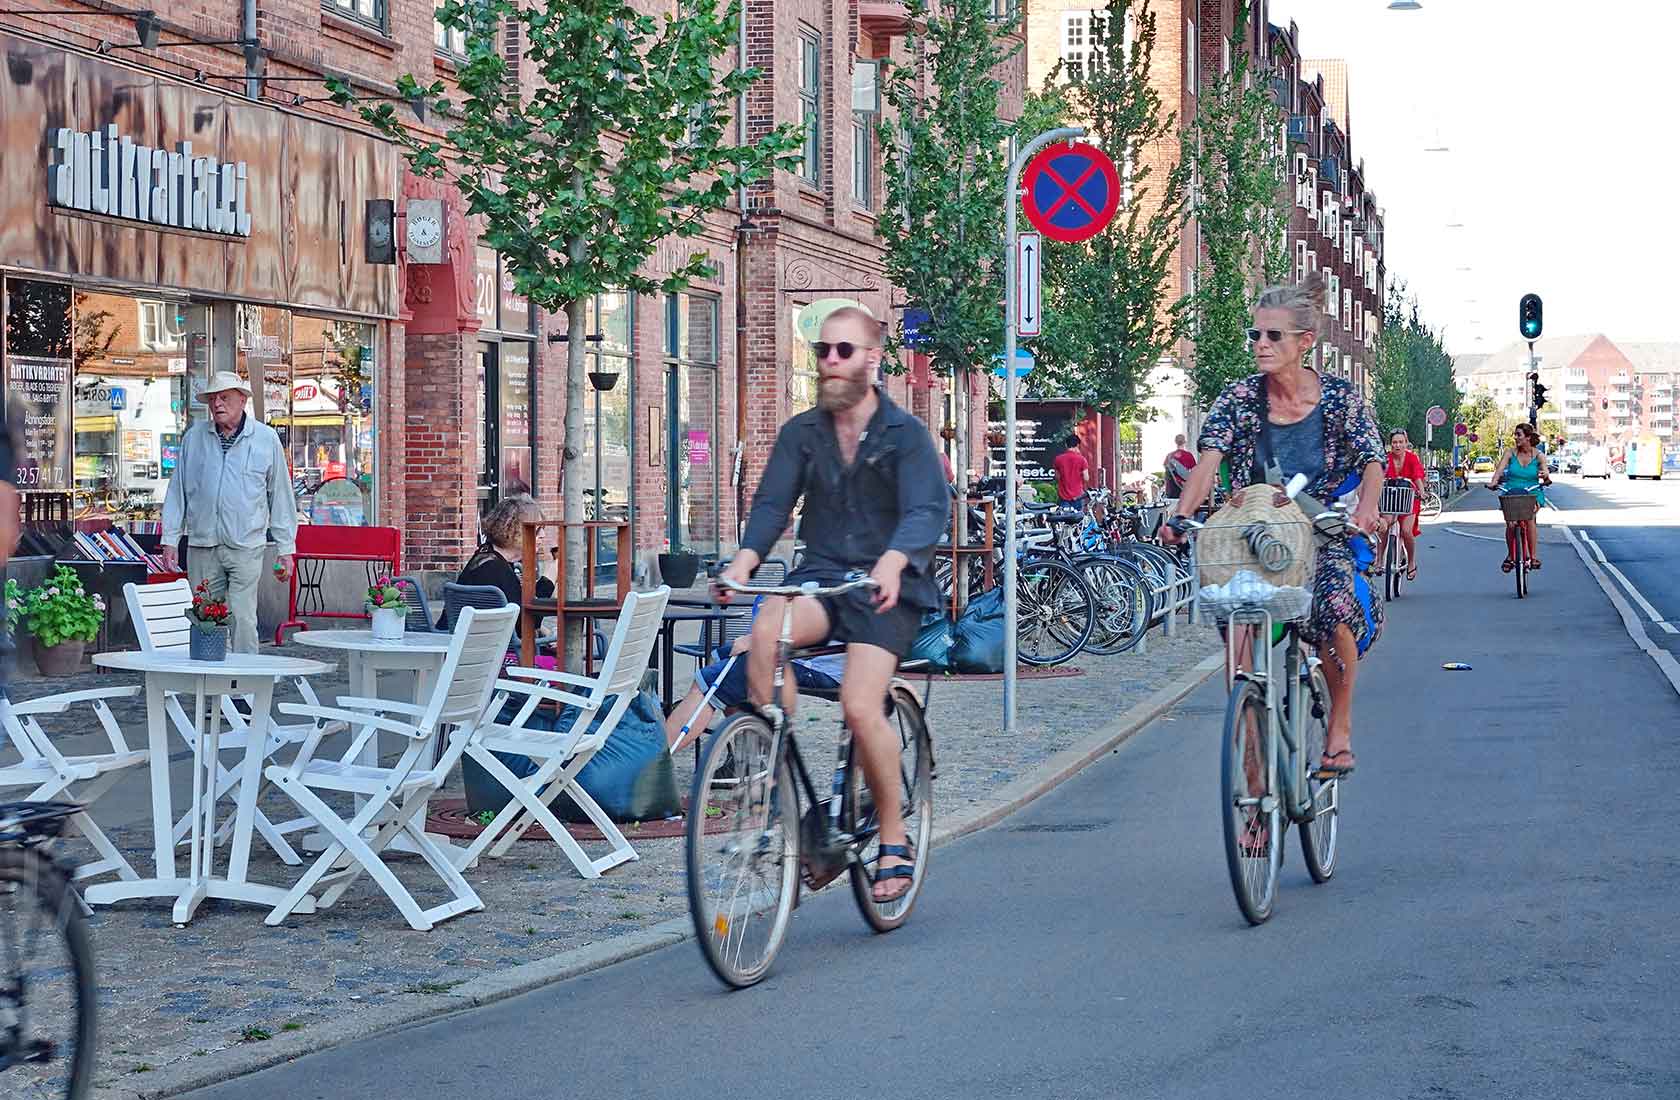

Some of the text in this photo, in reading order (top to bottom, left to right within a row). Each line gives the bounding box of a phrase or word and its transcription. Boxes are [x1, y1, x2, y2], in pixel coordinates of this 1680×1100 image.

[54, 123, 251, 236] antikvariatet
[476, 273, 494, 315] 20
[16, 467, 27, 484] 32
[29, 467, 40, 484] 57
